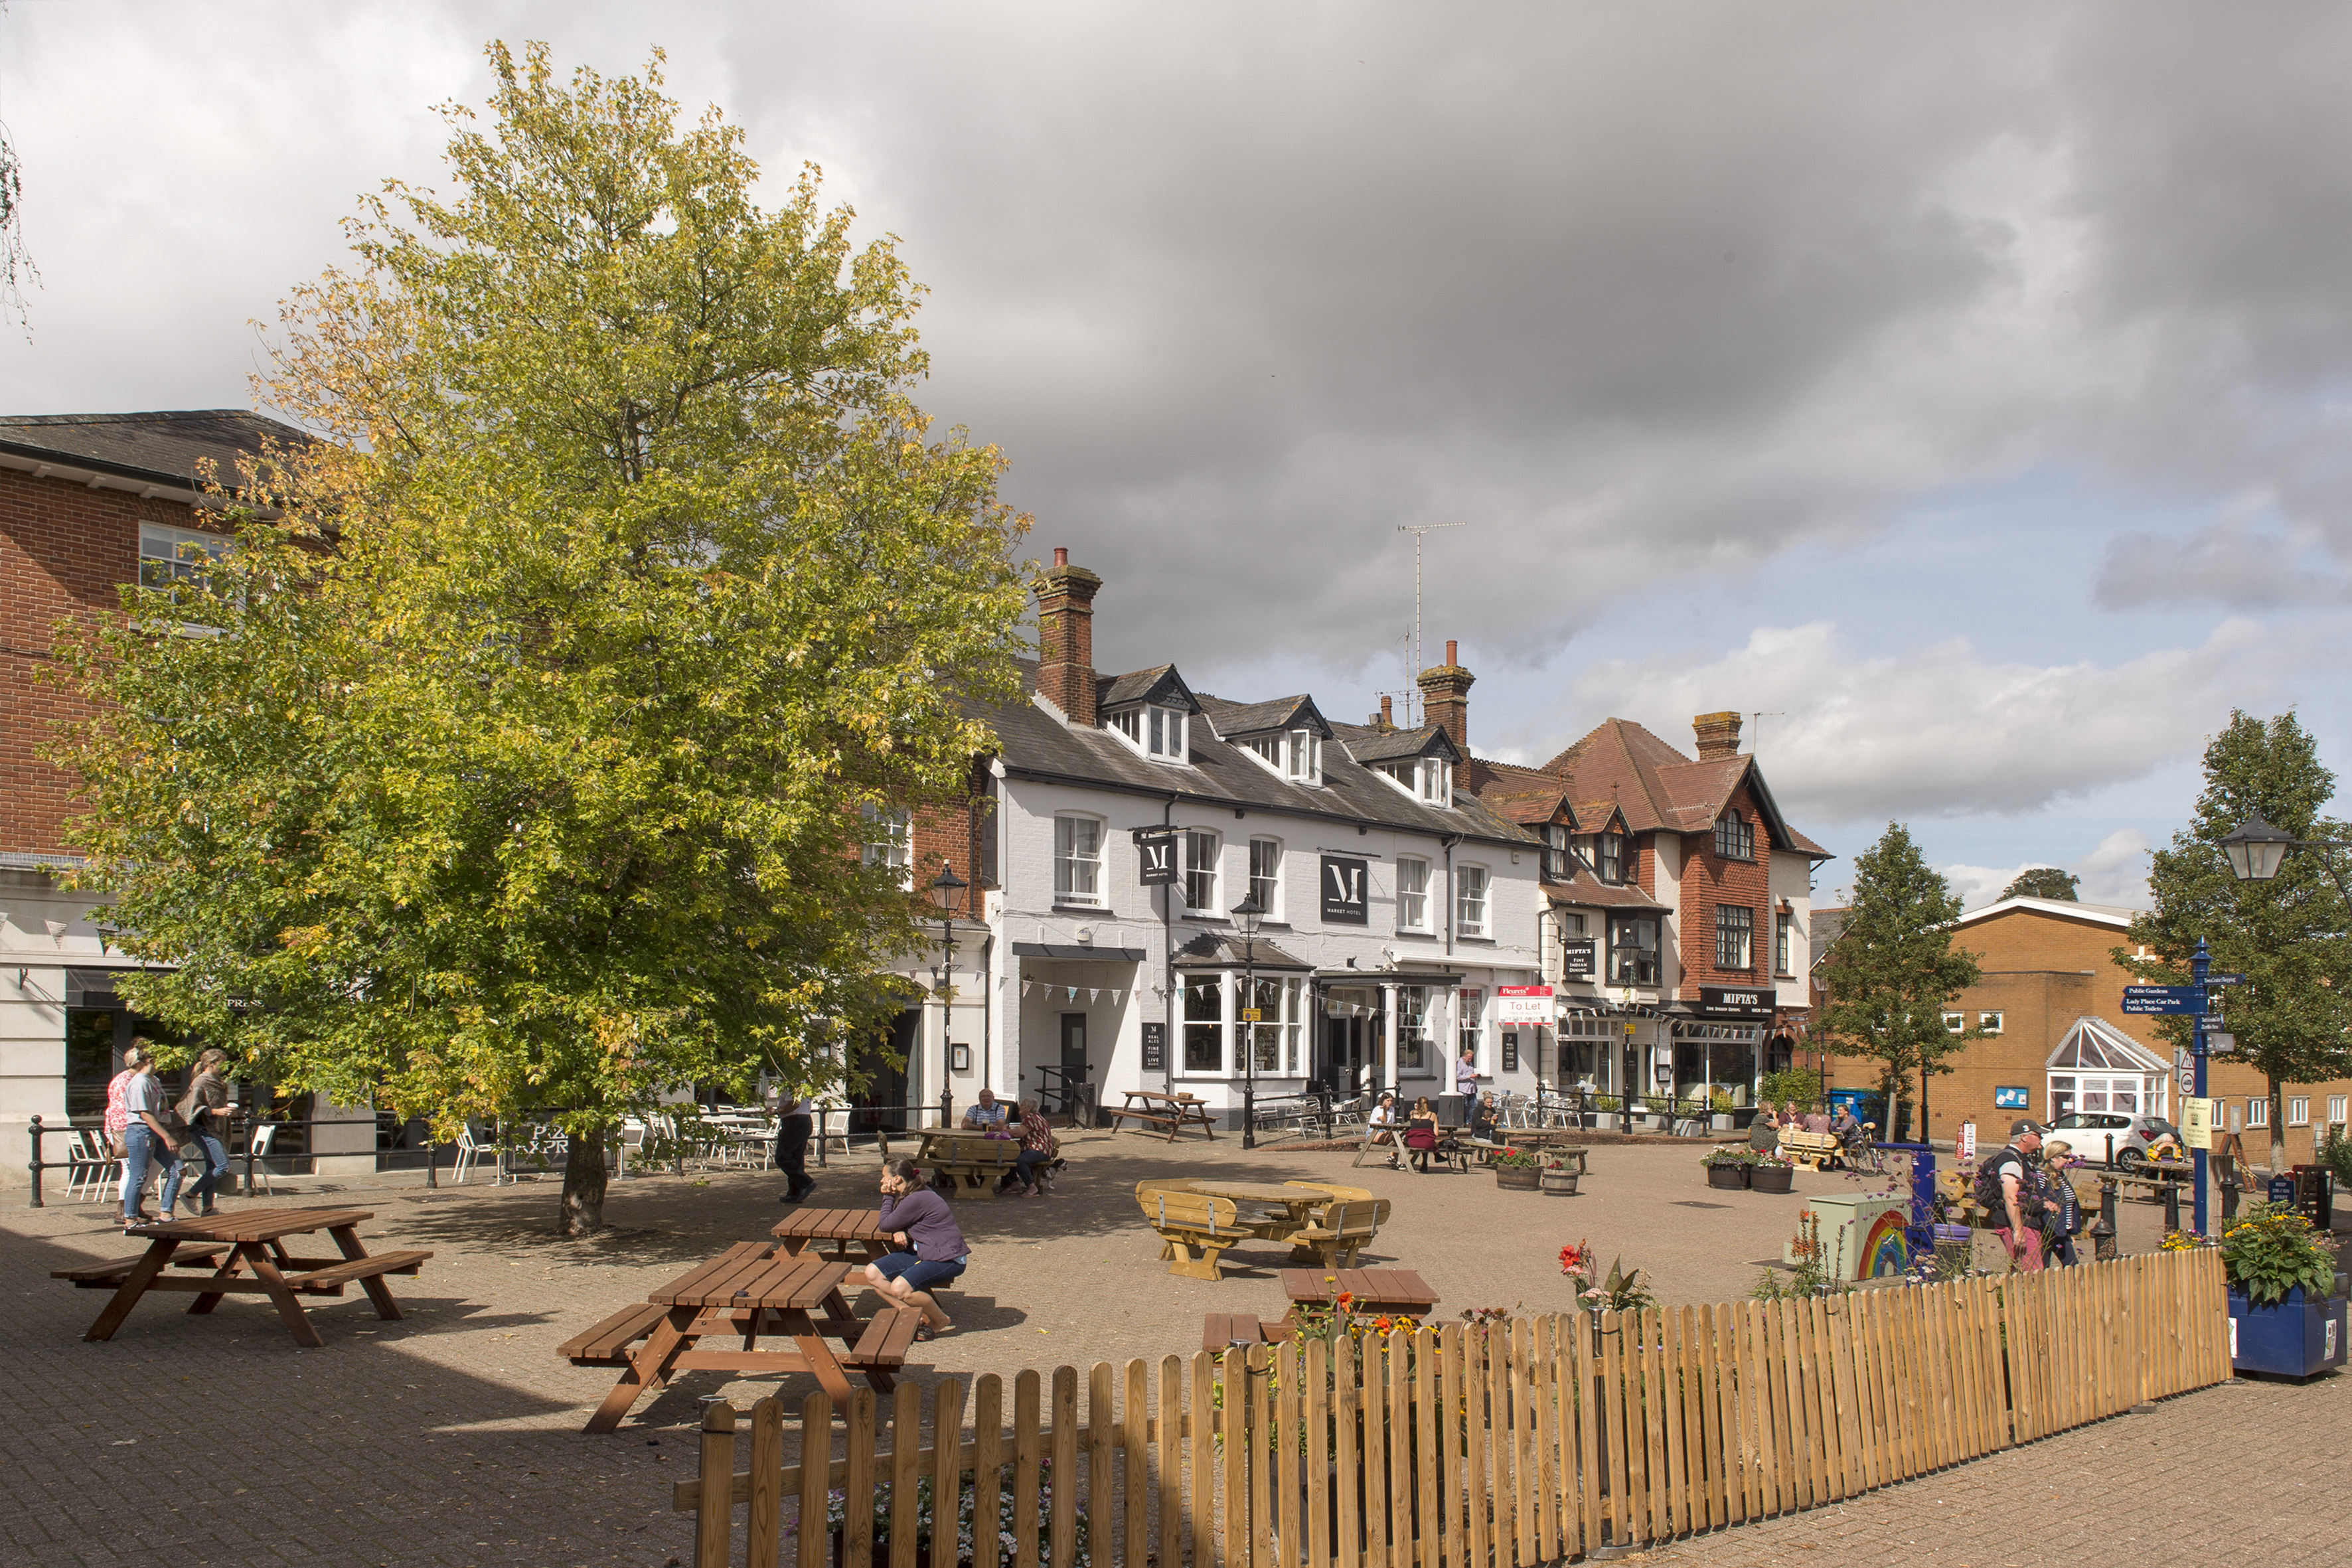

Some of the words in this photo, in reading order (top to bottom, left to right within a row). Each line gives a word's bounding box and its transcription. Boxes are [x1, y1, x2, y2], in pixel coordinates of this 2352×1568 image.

[1723, 993, 1758, 1004] MIFTA'S
[1510, 1001, 1522, 1010] To
[1526, 1001, 1541, 1010] Let
